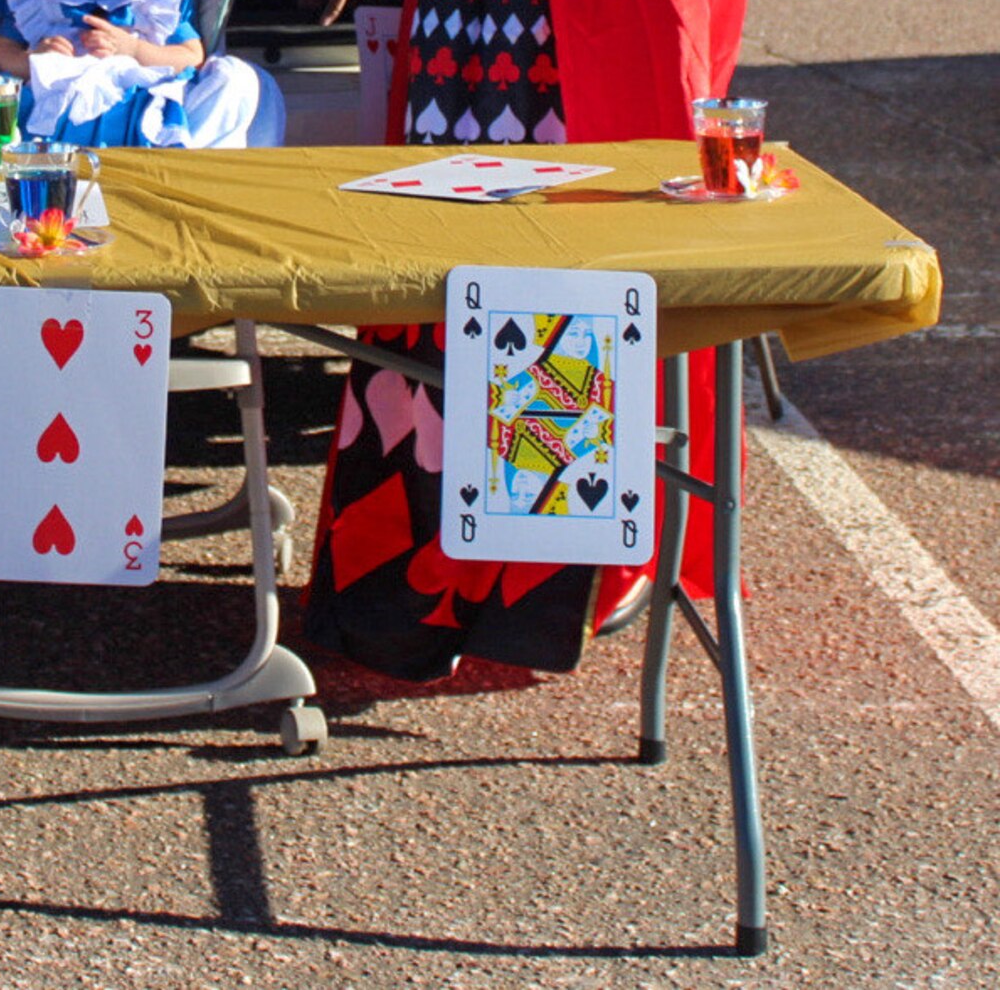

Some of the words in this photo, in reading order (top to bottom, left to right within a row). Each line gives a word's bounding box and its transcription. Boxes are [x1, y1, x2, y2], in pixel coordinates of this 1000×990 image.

[465, 281, 482, 310] Q
[624, 288, 640, 316] Q
[134, 310, 154, 339] 3
